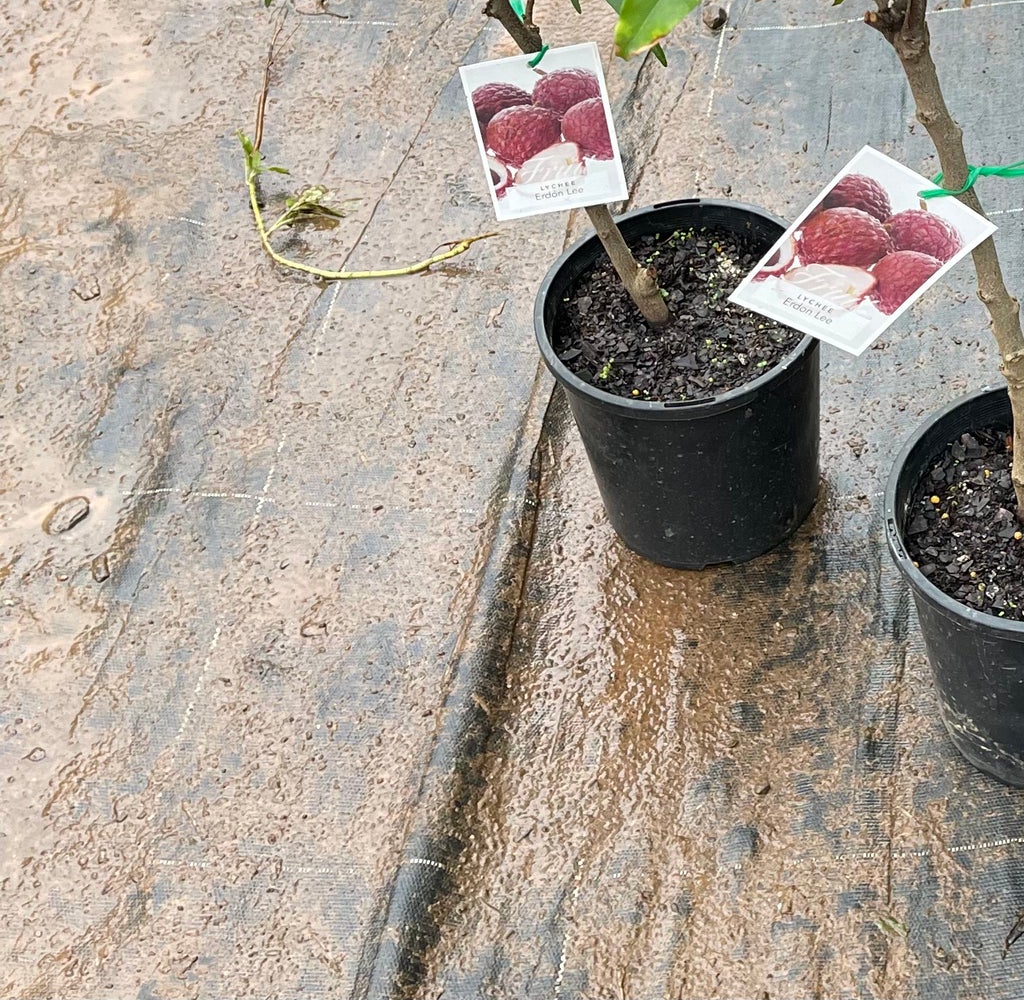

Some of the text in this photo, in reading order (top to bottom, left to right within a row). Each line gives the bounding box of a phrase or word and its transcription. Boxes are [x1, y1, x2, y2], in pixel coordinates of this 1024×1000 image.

[540, 181, 577, 191] LYCHEE
[566, 187, 584, 196] Lee
[782, 297, 833, 325] Erdon Lee
[797, 294, 835, 314] LYCHEE
